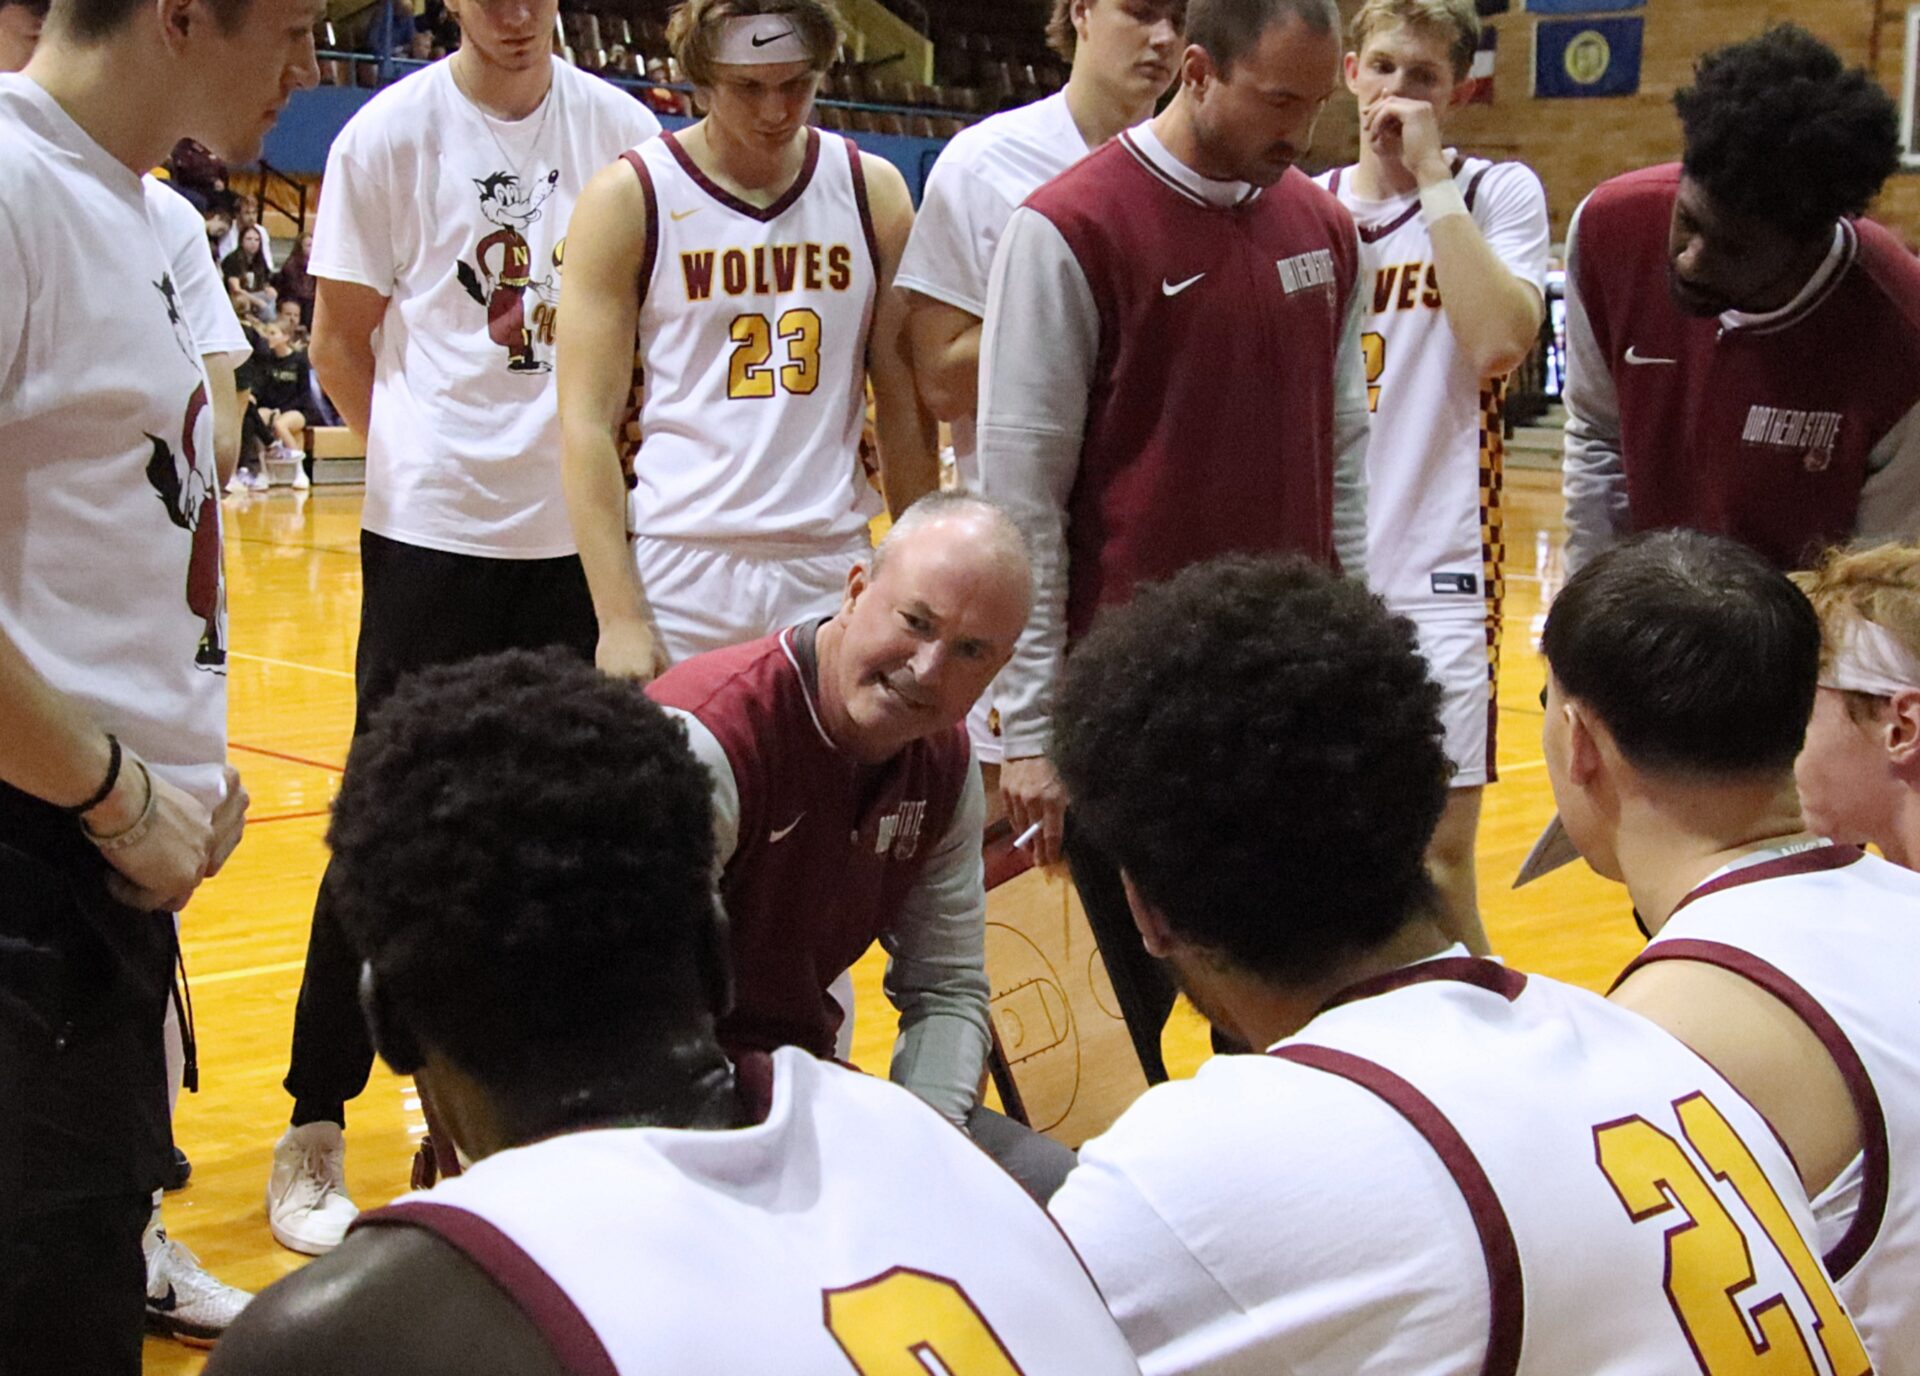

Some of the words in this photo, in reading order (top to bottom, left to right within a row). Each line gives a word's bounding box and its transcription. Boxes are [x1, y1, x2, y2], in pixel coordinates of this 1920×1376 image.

[512, 246, 529, 266] N
[680, 242, 852, 302] WOLVES
[727, 307, 822, 399] 23
[1592, 1089, 1875, 1376] 21
